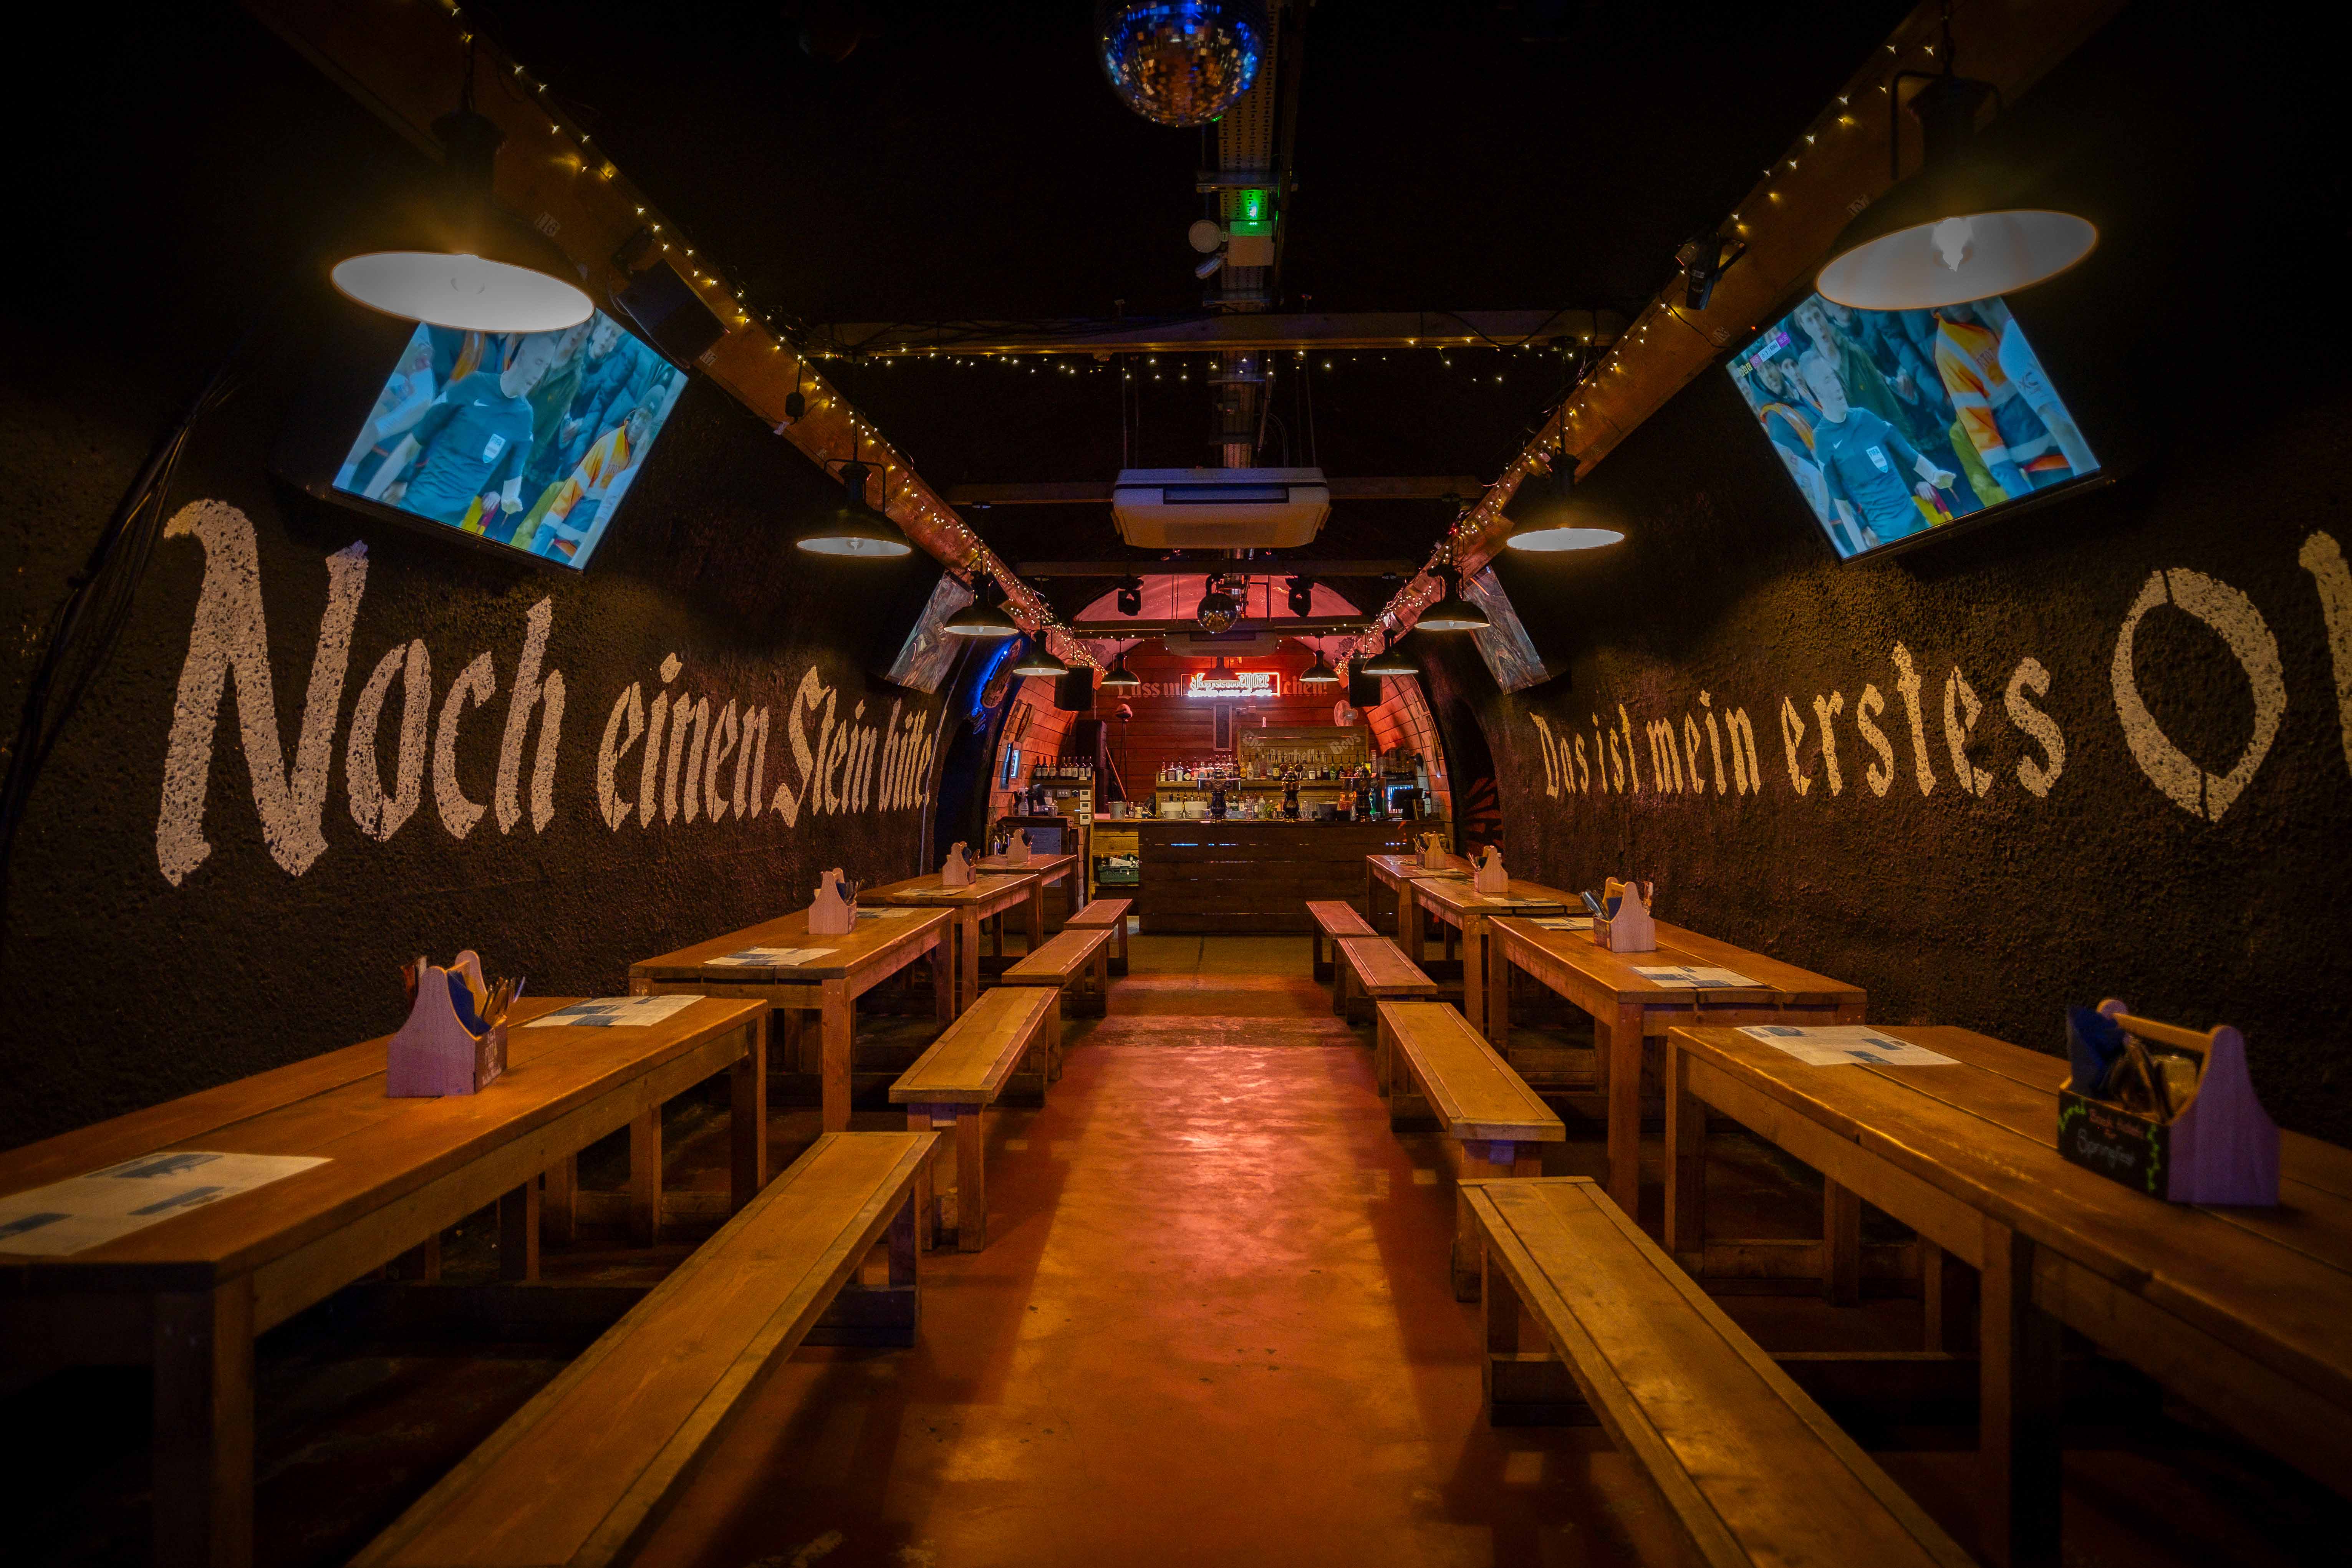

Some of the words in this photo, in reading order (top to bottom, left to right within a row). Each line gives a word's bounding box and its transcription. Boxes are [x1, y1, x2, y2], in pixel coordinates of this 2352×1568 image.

[156, 498, 566, 887] Noch
[597, 652, 769, 832] einen
[770, 664, 877, 828] Stein
[1529, 711, 1588, 800] Das
[1592, 703, 1640, 795] ist
[1646, 689, 1761, 796] mein
[1782, 641, 2065, 798] erstes
